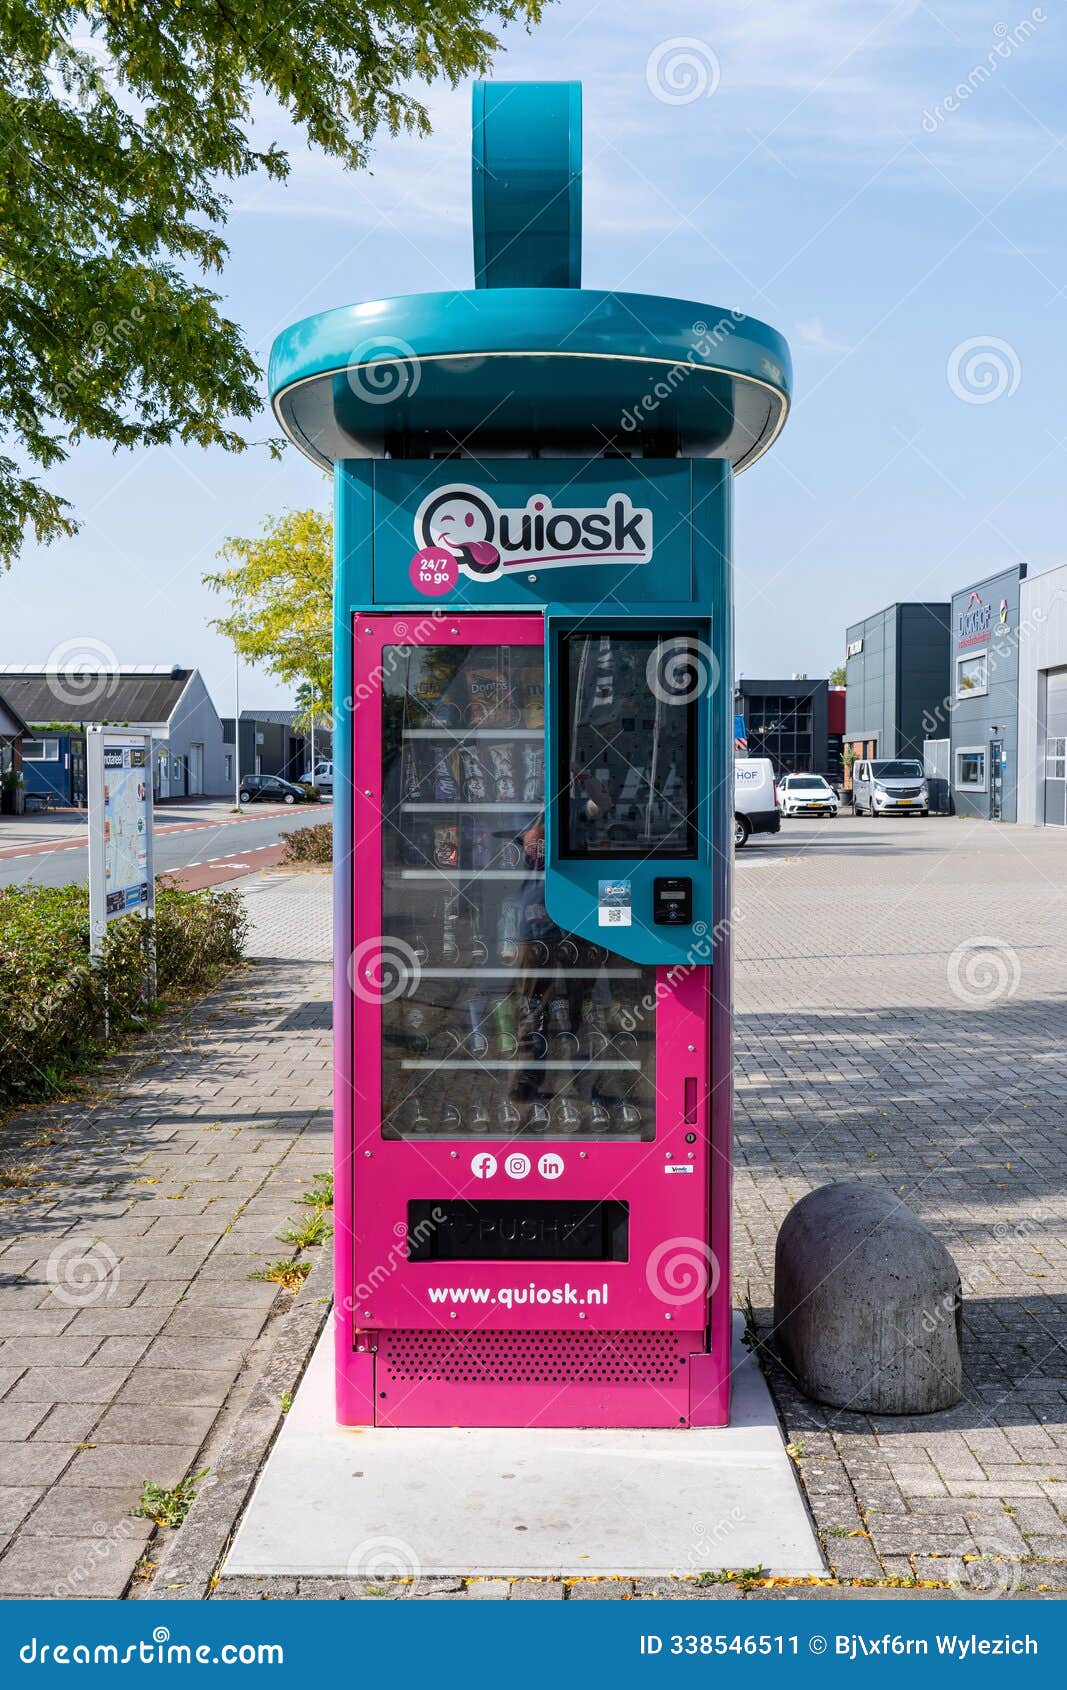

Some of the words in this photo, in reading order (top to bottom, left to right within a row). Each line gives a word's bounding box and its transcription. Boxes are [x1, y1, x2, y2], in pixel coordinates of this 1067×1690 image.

[421, 491, 646, 574] Quiosk
[420, 559, 447, 570] 24/7
[419, 571, 433, 582] to
[434, 574, 449, 585] go
[428, 1283, 609, 1309] www.quiosk.nl
